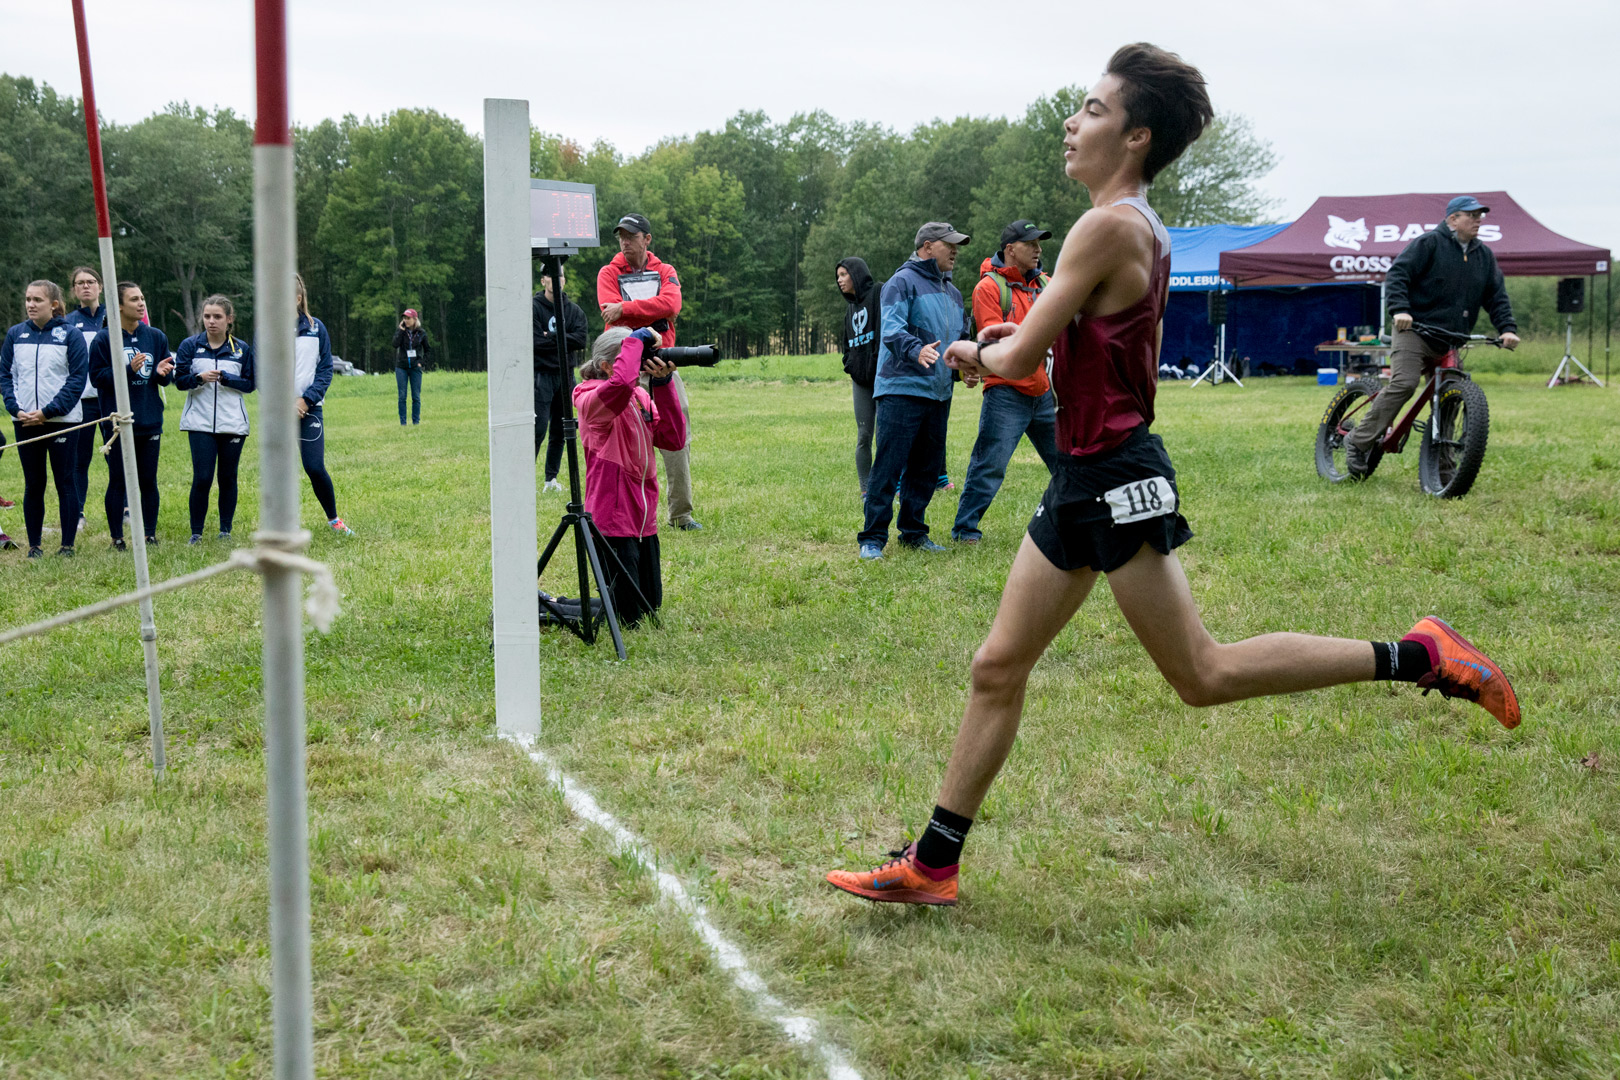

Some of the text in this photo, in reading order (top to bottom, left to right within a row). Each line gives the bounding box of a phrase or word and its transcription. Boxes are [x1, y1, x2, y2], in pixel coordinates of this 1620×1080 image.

[1374, 223, 1503, 243] BAS
[1329, 255, 1393, 273] CROSS
[1122, 480, 1162, 516] 118
